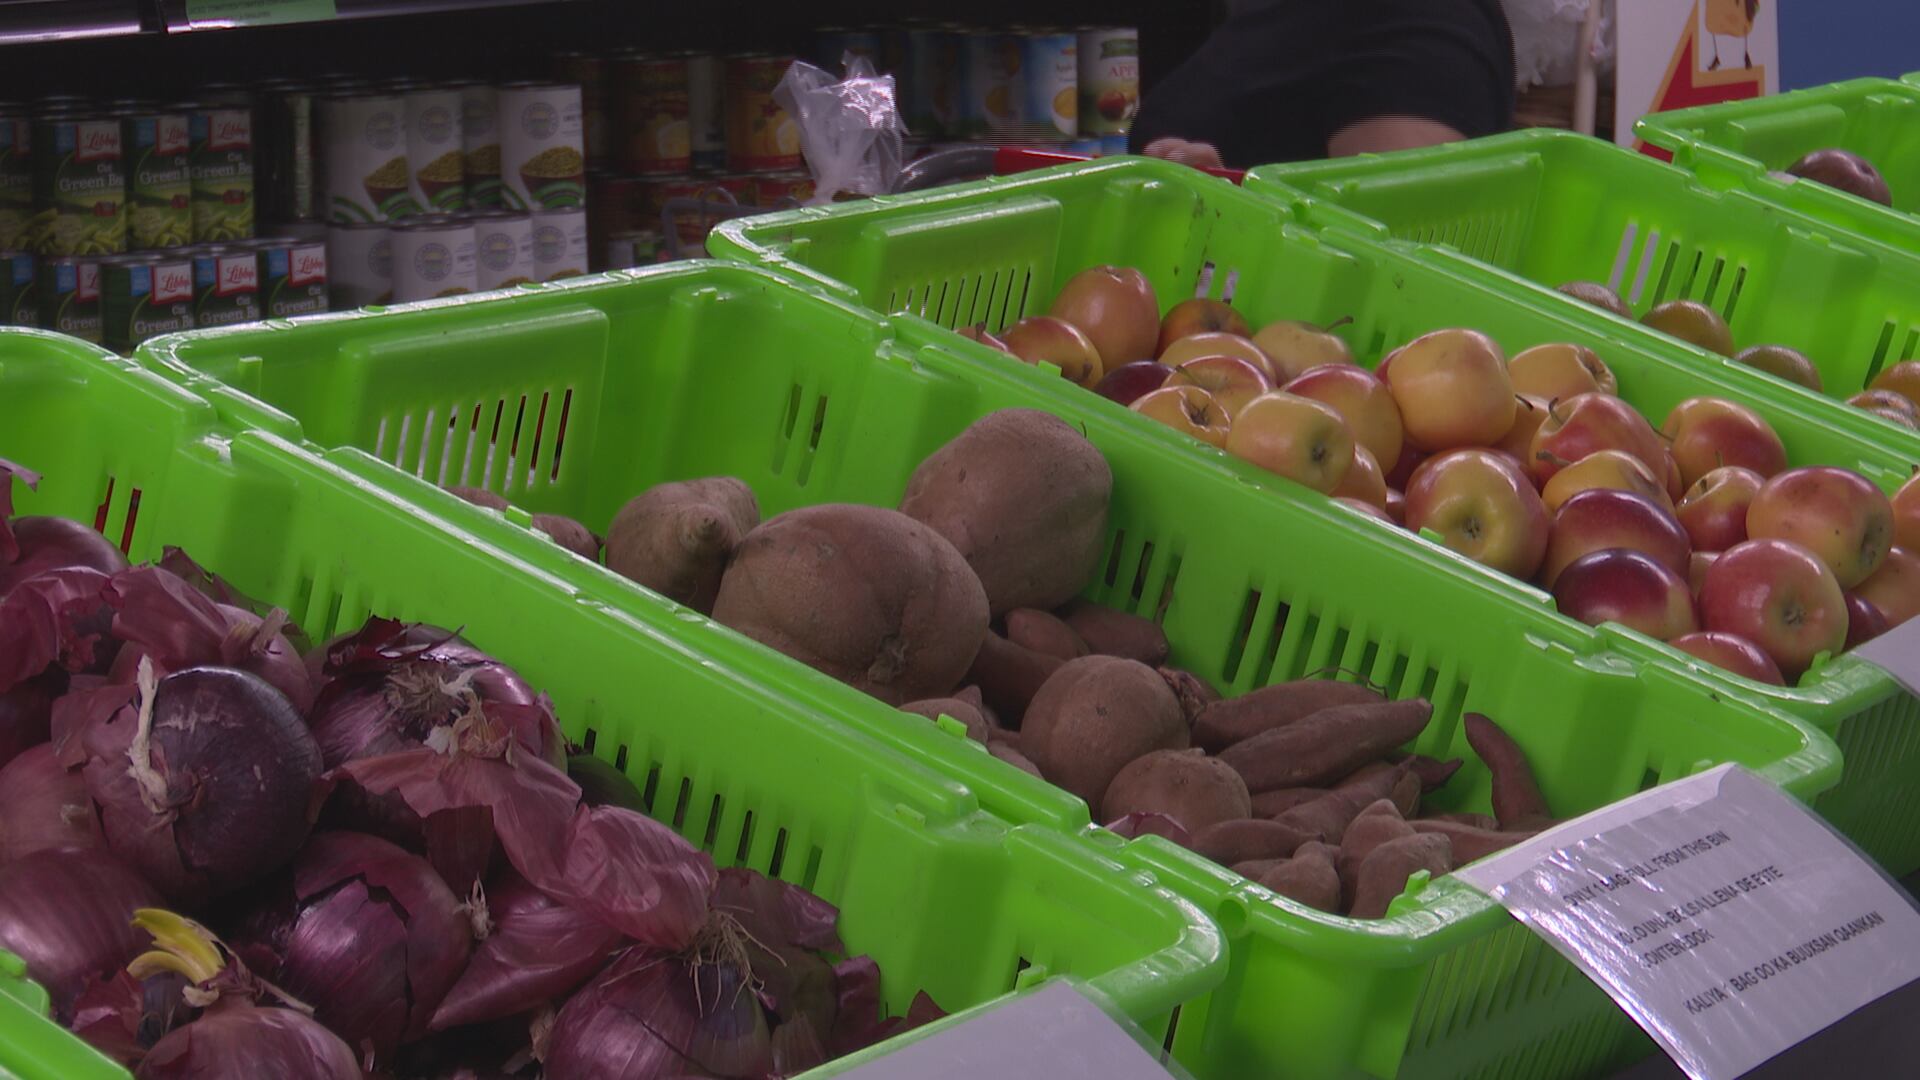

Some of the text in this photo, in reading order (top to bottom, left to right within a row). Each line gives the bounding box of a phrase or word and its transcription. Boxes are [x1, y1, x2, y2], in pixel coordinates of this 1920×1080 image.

[59, 176, 104, 192] Green
[134, 317, 178, 335] Green
[201, 309, 243, 325] Green
[1652, 848, 1689, 870] FROM
[1682, 838, 1712, 857] THIS
[1706, 830, 1731, 847] BIN
[1703, 884, 1740, 908] LLENA
[1736, 874, 1758, 893] DE
[1685, 986, 1729, 1015] KALIYA
[1730, 971, 1759, 992] BAG
[1770, 954, 1793, 972] KA
[1786, 932, 1839, 965] BUUXSAN
[1833, 911, 1886, 942] QAANKAN
